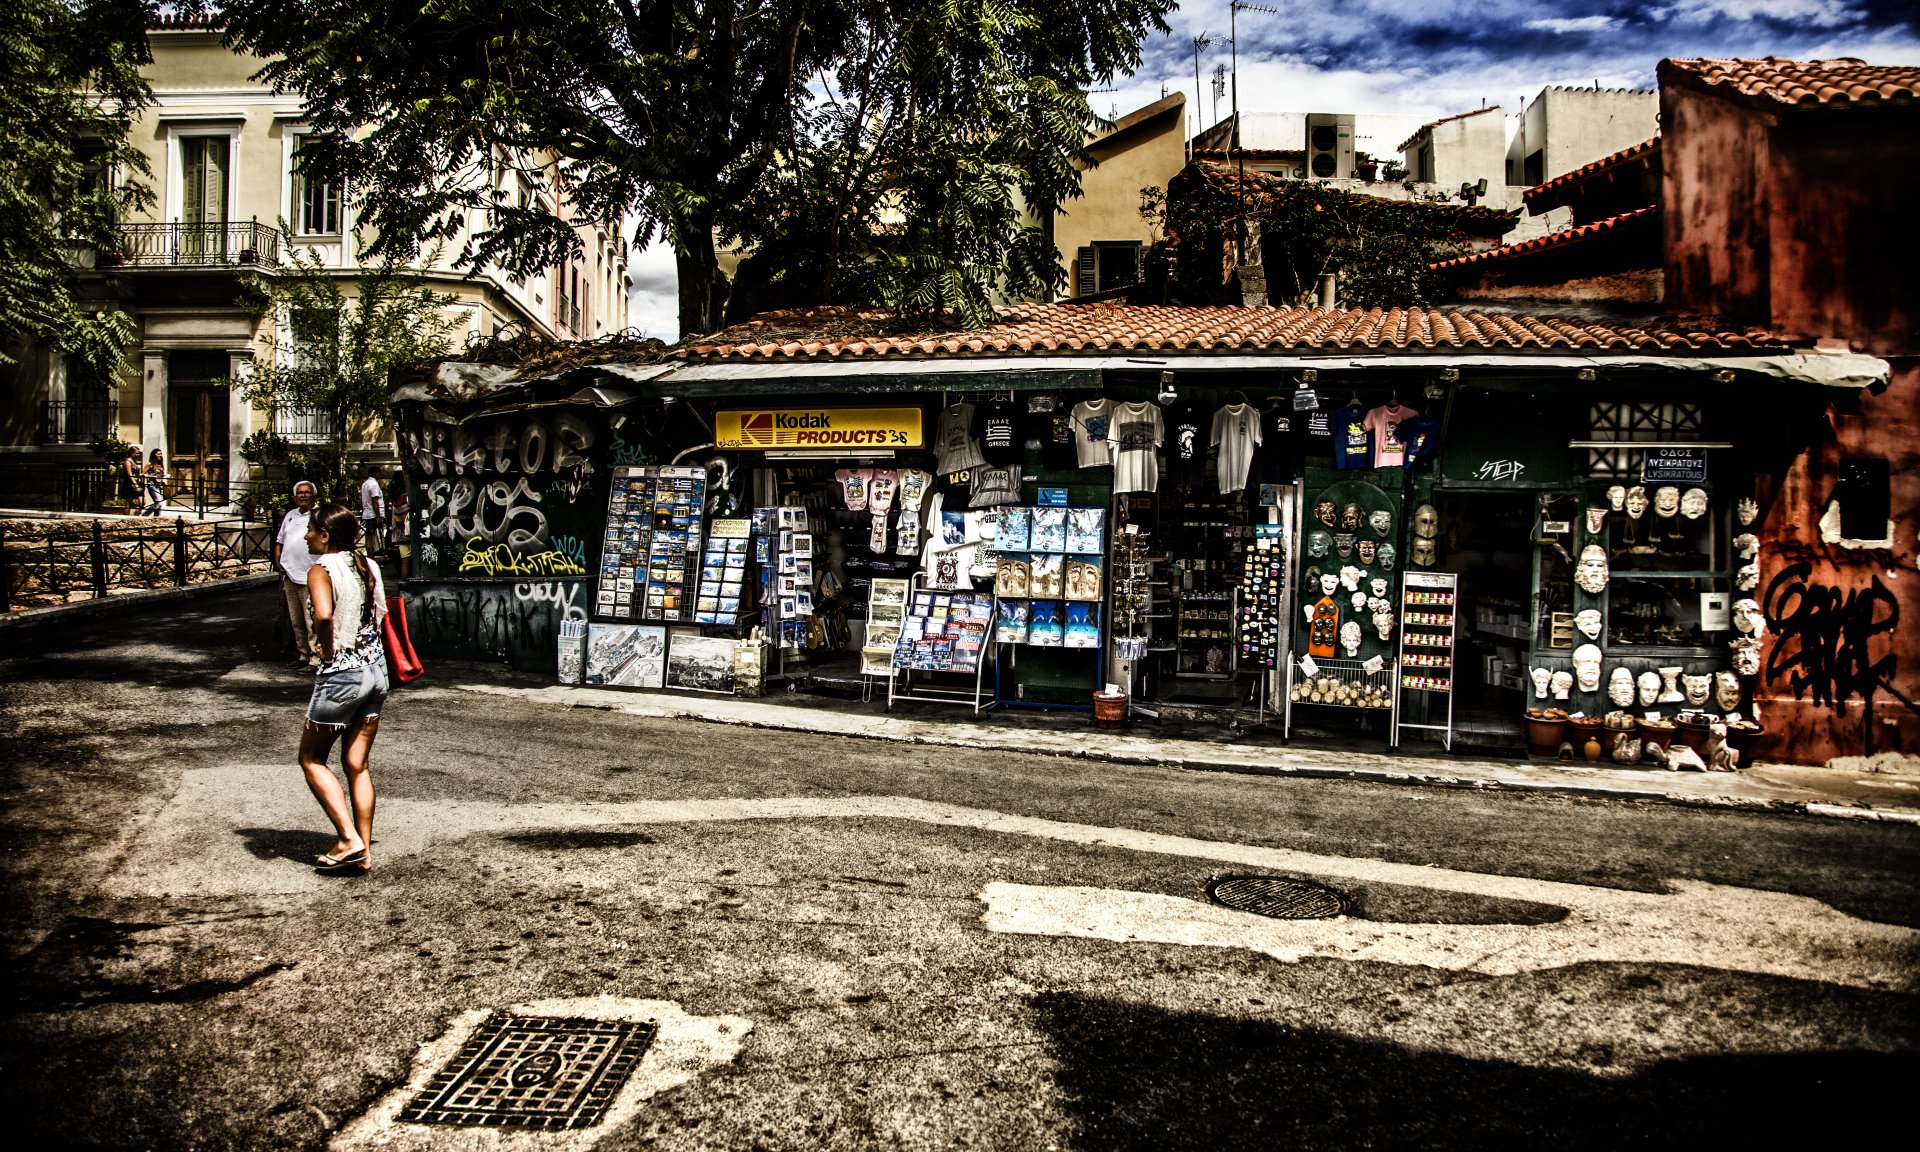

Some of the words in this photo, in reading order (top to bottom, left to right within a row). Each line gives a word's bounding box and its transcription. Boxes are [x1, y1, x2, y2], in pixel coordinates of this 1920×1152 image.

[776, 413, 831, 429] Kodak
[797, 430, 887, 445] PRODUCTS
[1659, 449, 1693, 457] ΟΔΟΣ
